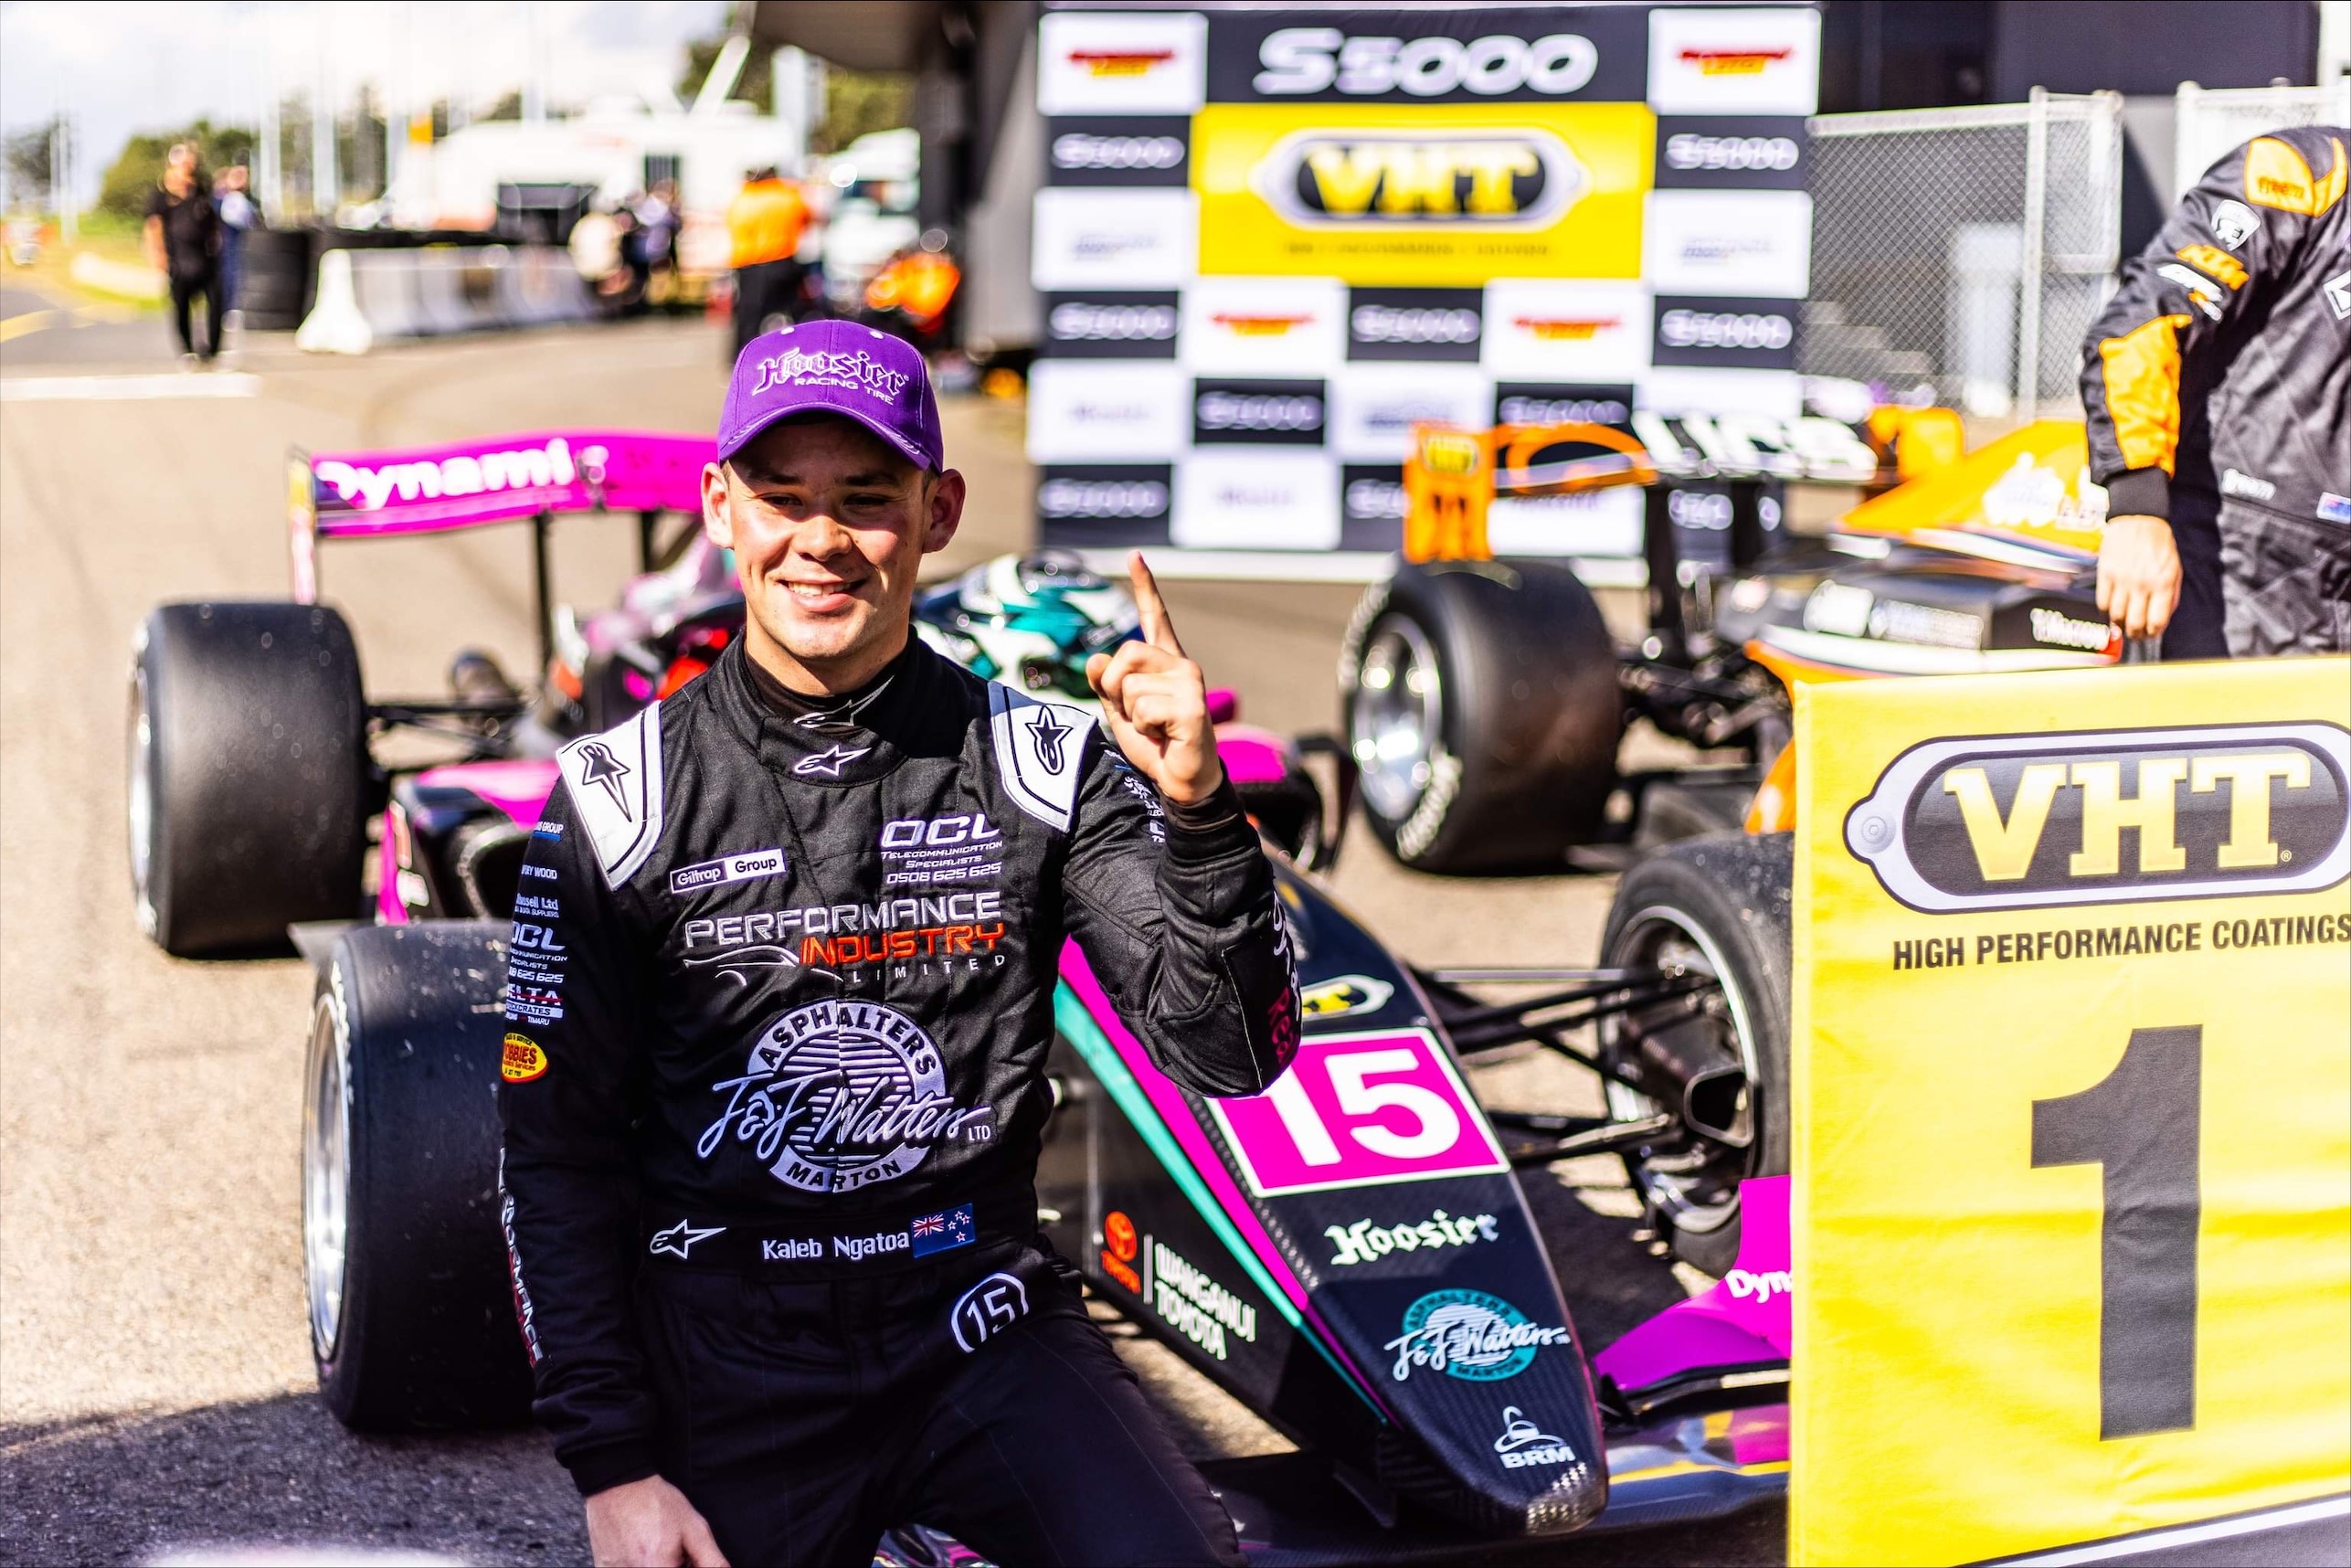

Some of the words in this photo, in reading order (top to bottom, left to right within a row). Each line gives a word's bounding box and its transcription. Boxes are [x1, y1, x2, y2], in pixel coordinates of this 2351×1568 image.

[1252, 27, 1598, 95] S5000
[1307, 142, 1540, 217] VHT
[752, 347, 905, 396] Hoosier
[794, 376, 858, 390] RACING
[863, 387, 895, 406] TIRE
[542, 821, 564, 833] GROUP
[881, 813, 1001, 848] OCL
[1944, 751, 2312, 882] VHT
[535, 866, 558, 880] WOOD
[677, 866, 721, 886] Giltrap
[735, 856, 778, 874] Group
[886, 871, 931, 885] 0508
[932, 867, 968, 882] 625
[969, 862, 1002, 877] 625
[541, 897, 559, 911] Ltd
[685, 891, 1001, 948] PERFORMANCE
[800, 922, 1005, 967] INDUSTRY
[1893, 937, 1965, 970] HIGH
[1976, 922, 2202, 966] PERFORMANCE
[2211, 914, 2351, 950] COATINGS
[536, 972, 564, 984] 625
[853, 955, 1005, 984] LIMITED
[760, 1006, 937, 1076] ASPHALTERS
[813, 1075, 991, 1143] Watters
[968, 1125, 991, 1141] LTD
[1261, 1049, 1460, 1167] 15
[787, 1160, 903, 1191] MARTON
[762, 1239, 822, 1260] Kaleb
[832, 1231, 910, 1262] Ngatoa
[1325, 1209, 1498, 1266] Hoosier
[2030, 1024, 2204, 1443] 1
[966, 1287, 1017, 1342] 15
[1154, 1243, 1256, 1342] WANGANUI
[1154, 1280, 1227, 1361] TOYOTA
[1499, 1446, 1576, 1469] BRM
